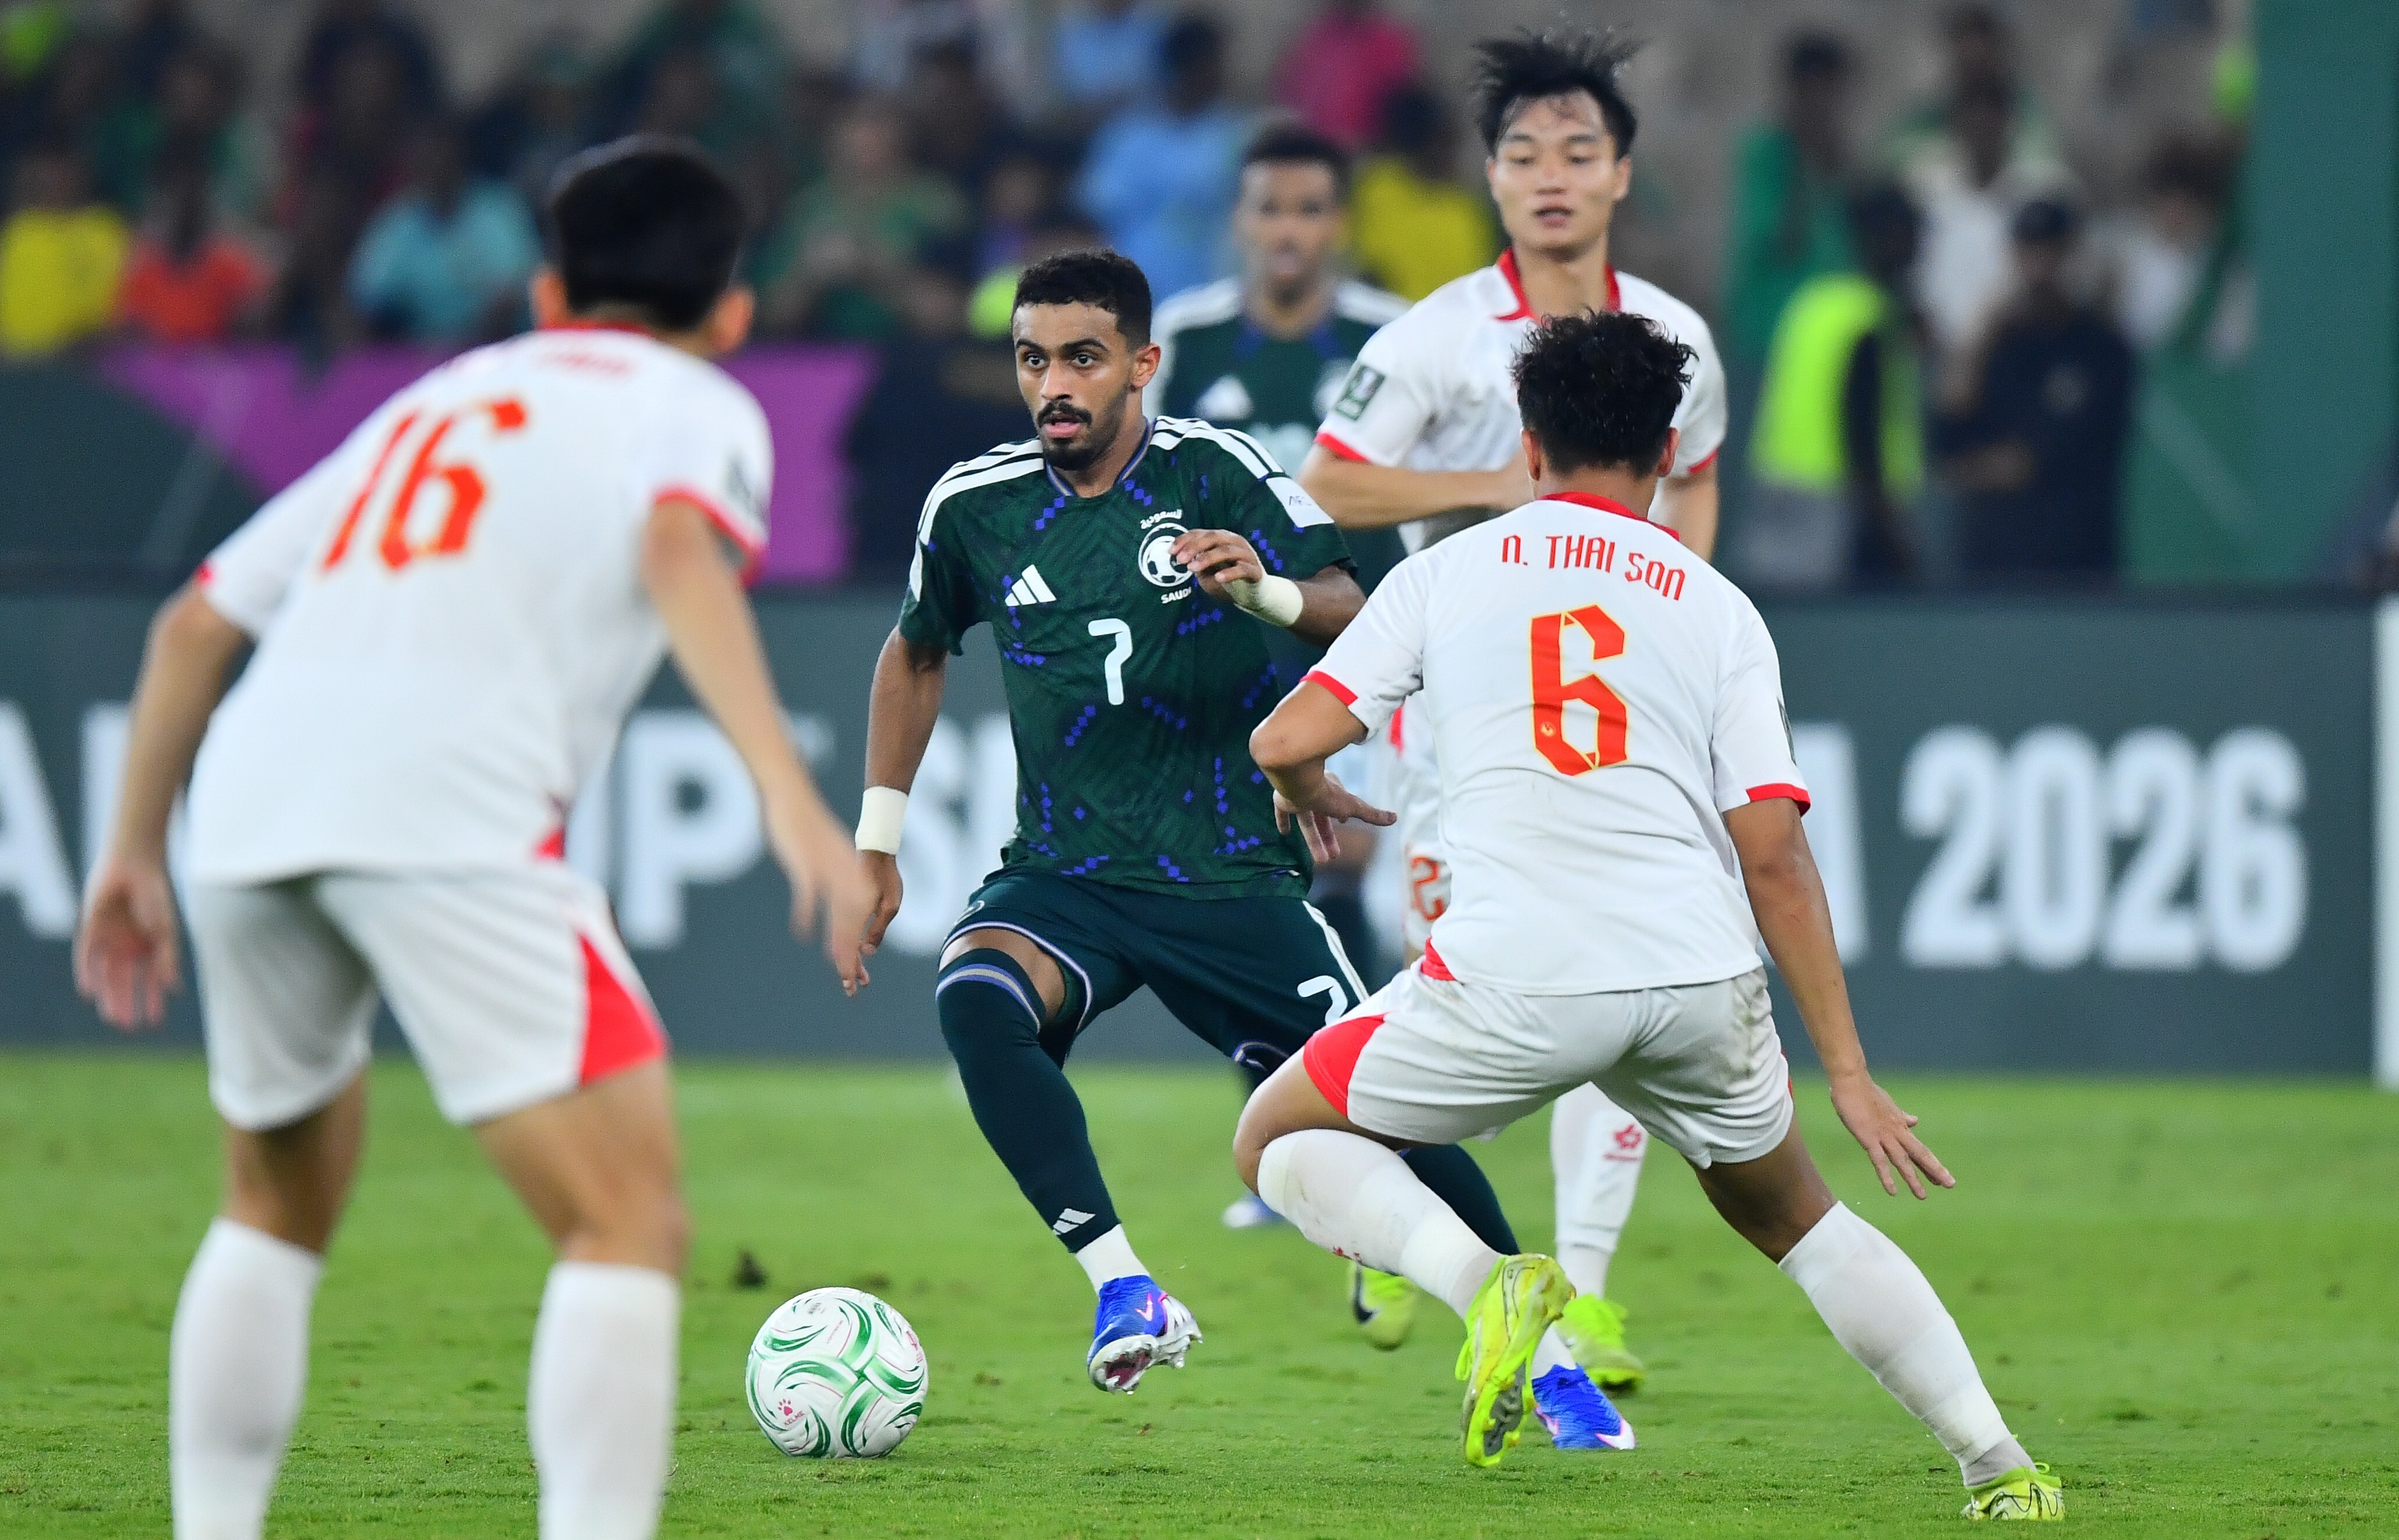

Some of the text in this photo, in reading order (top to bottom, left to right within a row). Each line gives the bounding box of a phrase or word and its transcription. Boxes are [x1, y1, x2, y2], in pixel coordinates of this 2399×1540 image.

[319, 395, 529, 575] 16
[1160, 586, 1192, 604] SAUDI
[1545, 534, 1616, 573] THAI
[1624, 552, 1686, 601] SON
[1087, 617, 1134, 706] 7
[1530, 604, 1628, 776] 6
[1899, 723, 2306, 971] 2026
[783, 1410, 805, 1426] KELME
